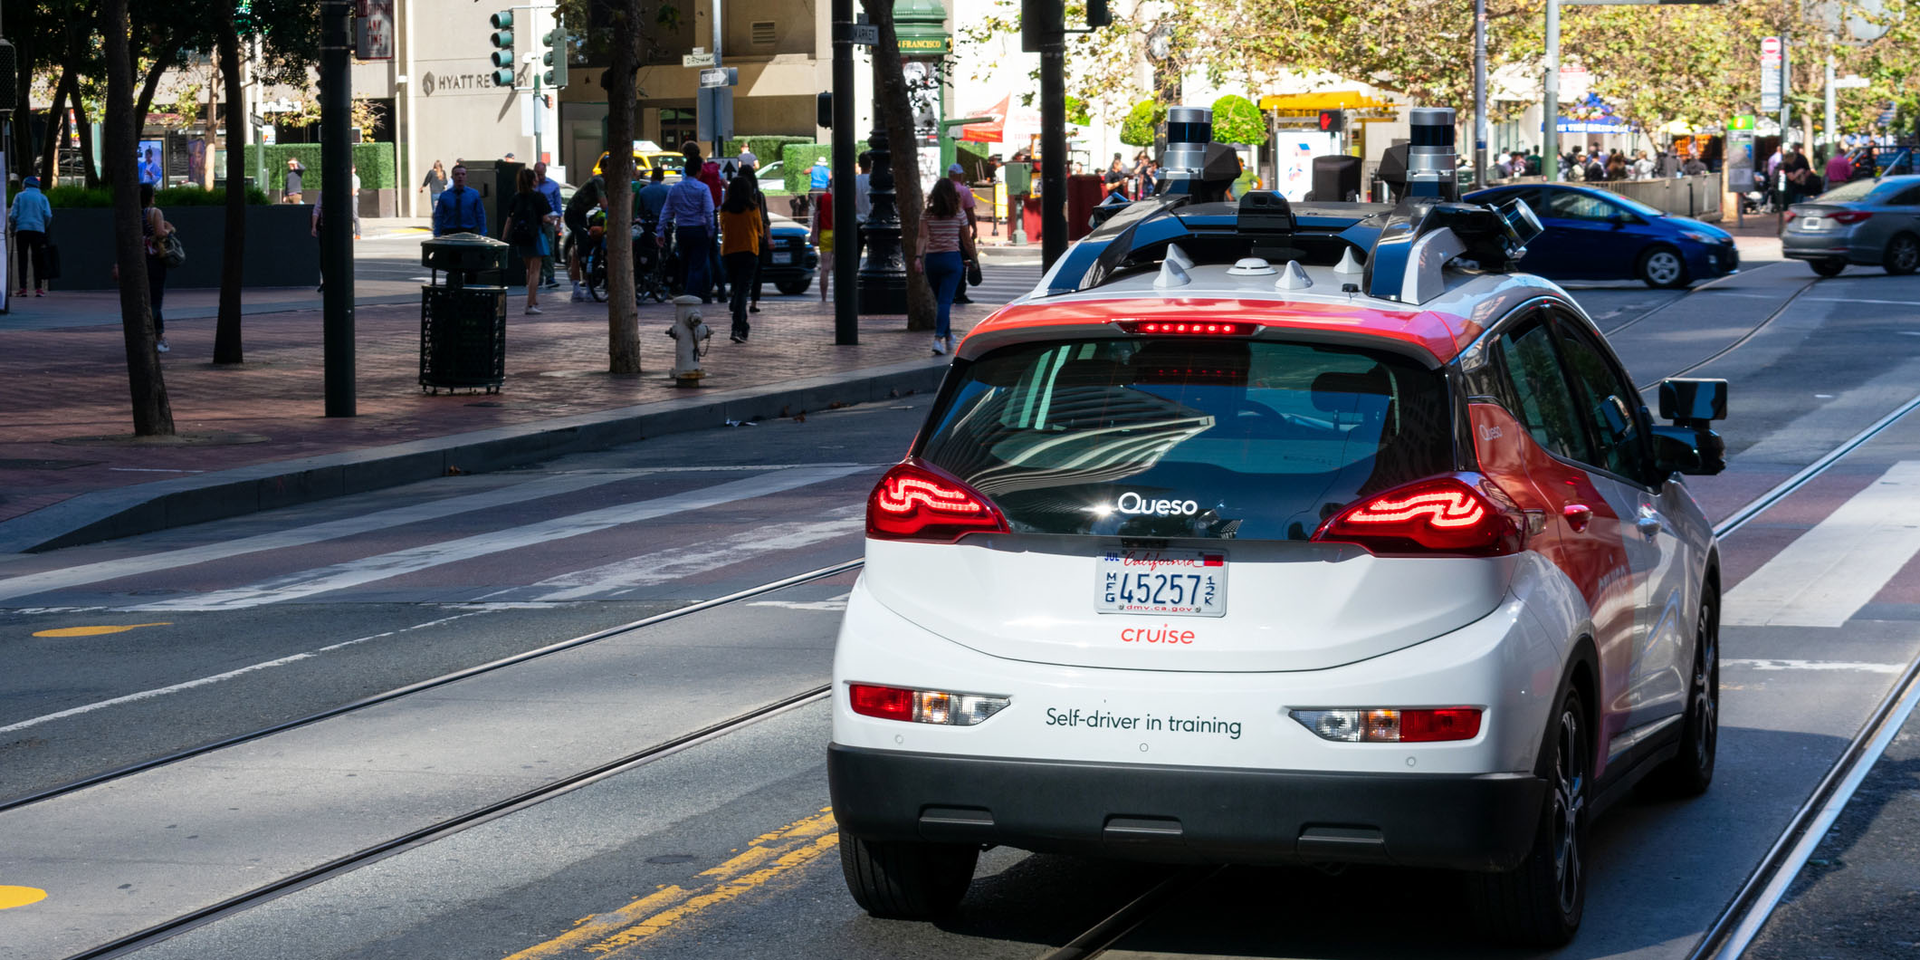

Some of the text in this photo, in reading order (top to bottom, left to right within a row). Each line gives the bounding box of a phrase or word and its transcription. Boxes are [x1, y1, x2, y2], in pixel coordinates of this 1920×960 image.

[368, 20, 381, 31] ANY
[367, 34, 382, 46] TIME
[902, 40, 941, 48] FRANCISCO
[438, 74, 474, 90] HYATT
[1118, 492, 1198, 515] Queso
[1104, 550, 1204, 571] JUL California
[1120, 573, 1201, 605] 45257
[1126, 604, 1193, 613] dmv.ca.gov
[1121, 623, 1195, 645] cruise
[1045, 707, 1242, 740] Self-driver in training
